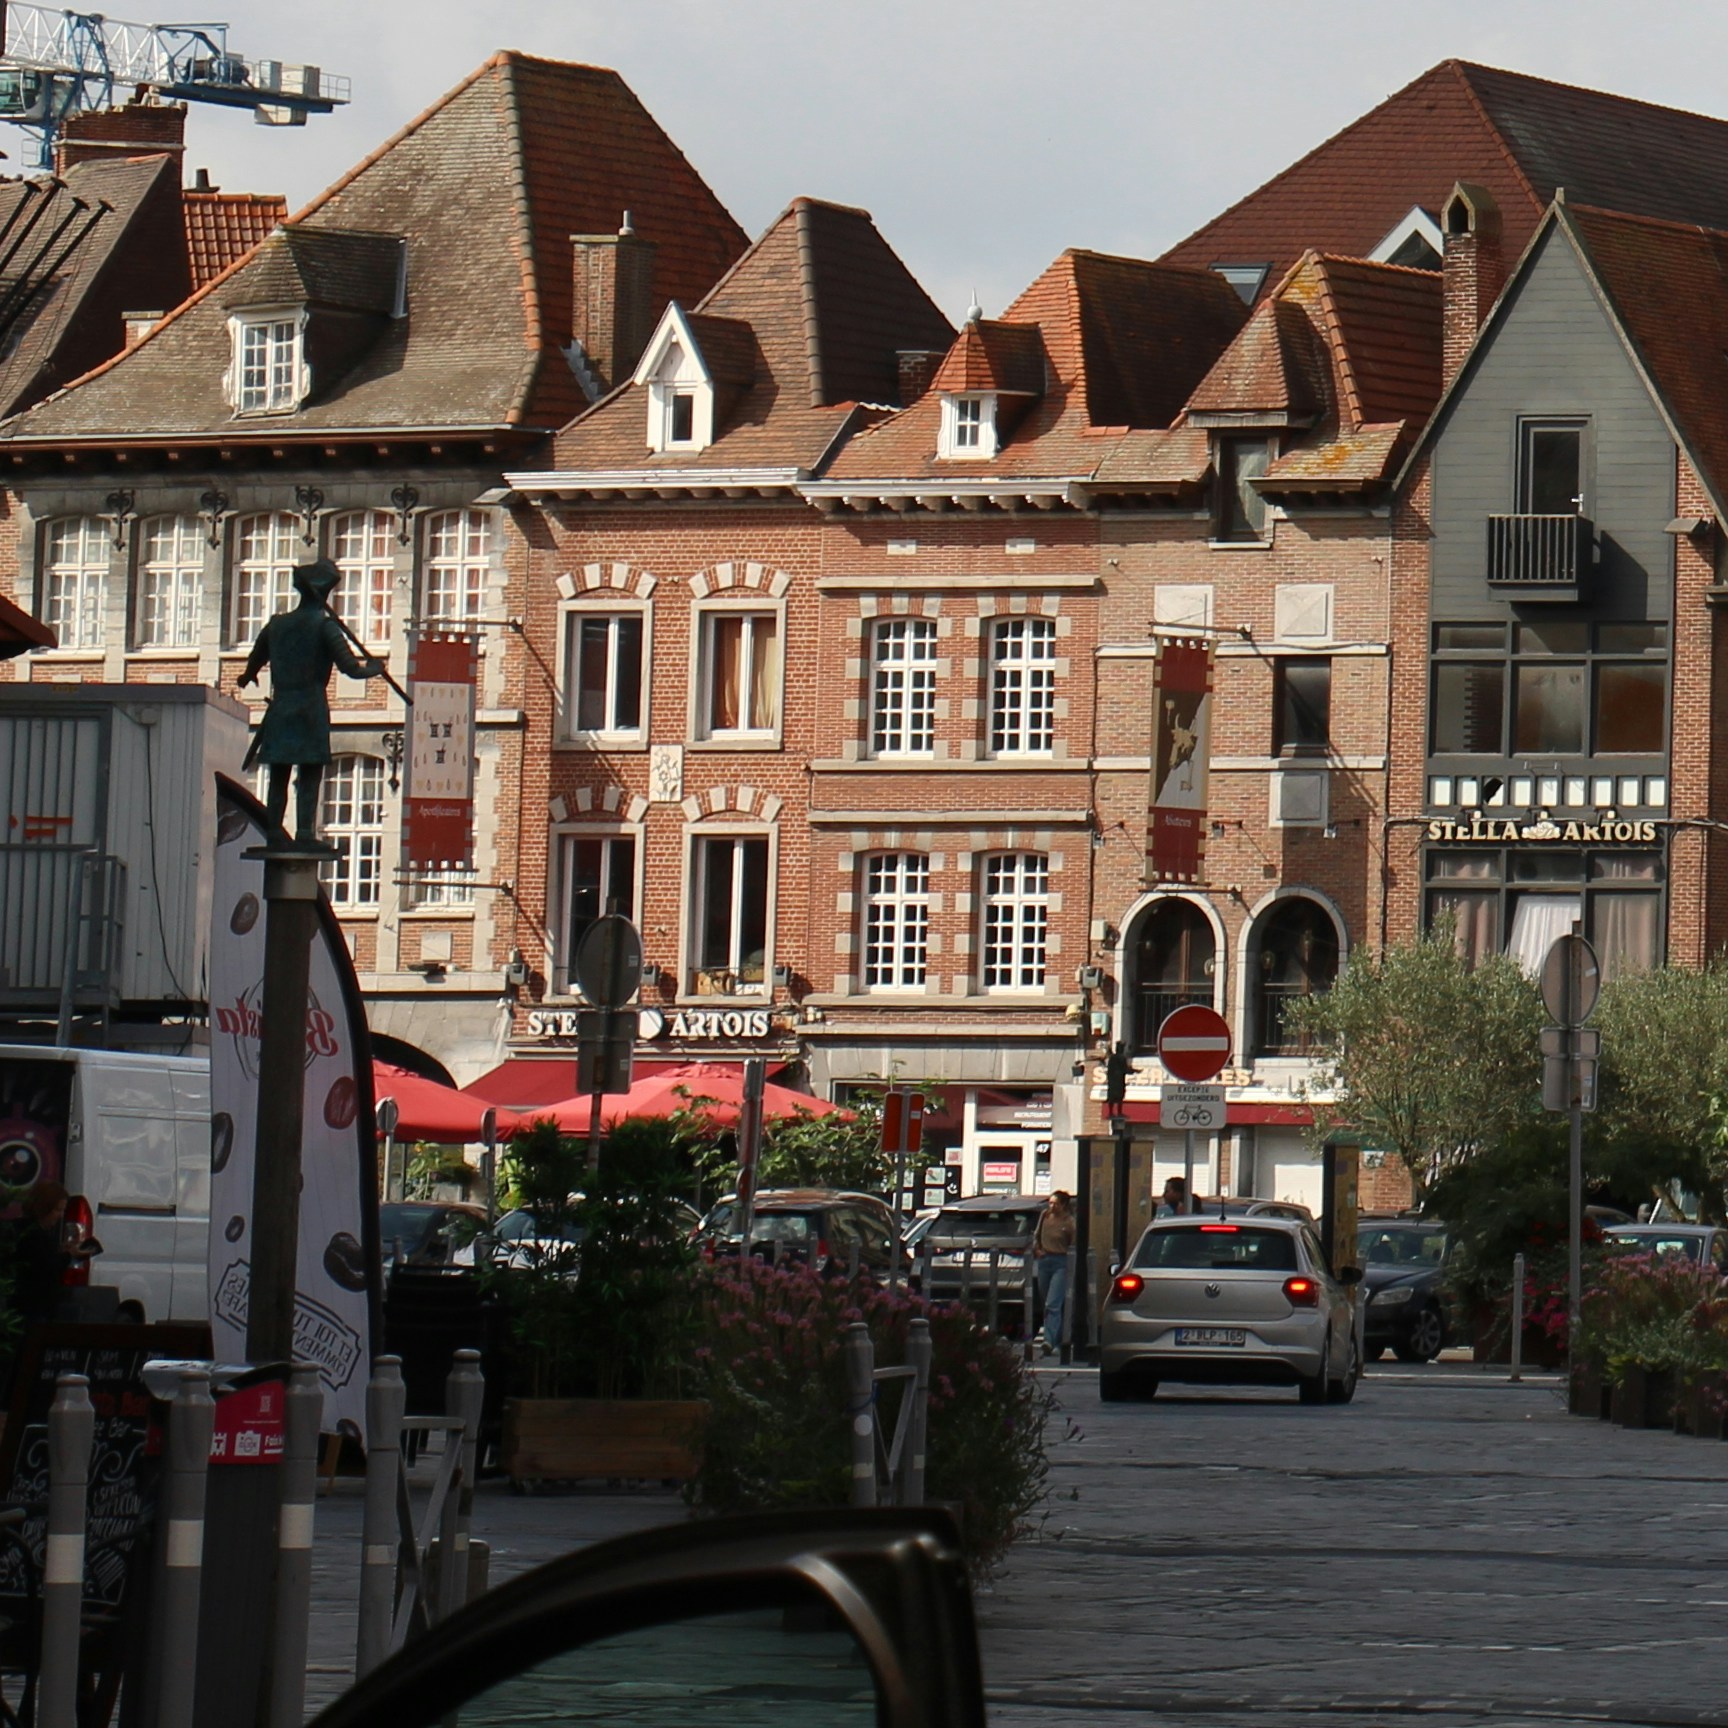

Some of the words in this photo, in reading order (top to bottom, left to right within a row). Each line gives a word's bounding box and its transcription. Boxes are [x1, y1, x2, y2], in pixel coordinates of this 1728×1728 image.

[1429, 821, 1519, 841] STELLA
[1562, 821, 1656, 841] ARTOIS
[527, 1011, 577, 1036] STE
[669, 1010, 770, 1037] ARTOIS
[1036, 1144, 1049, 1153] 47
